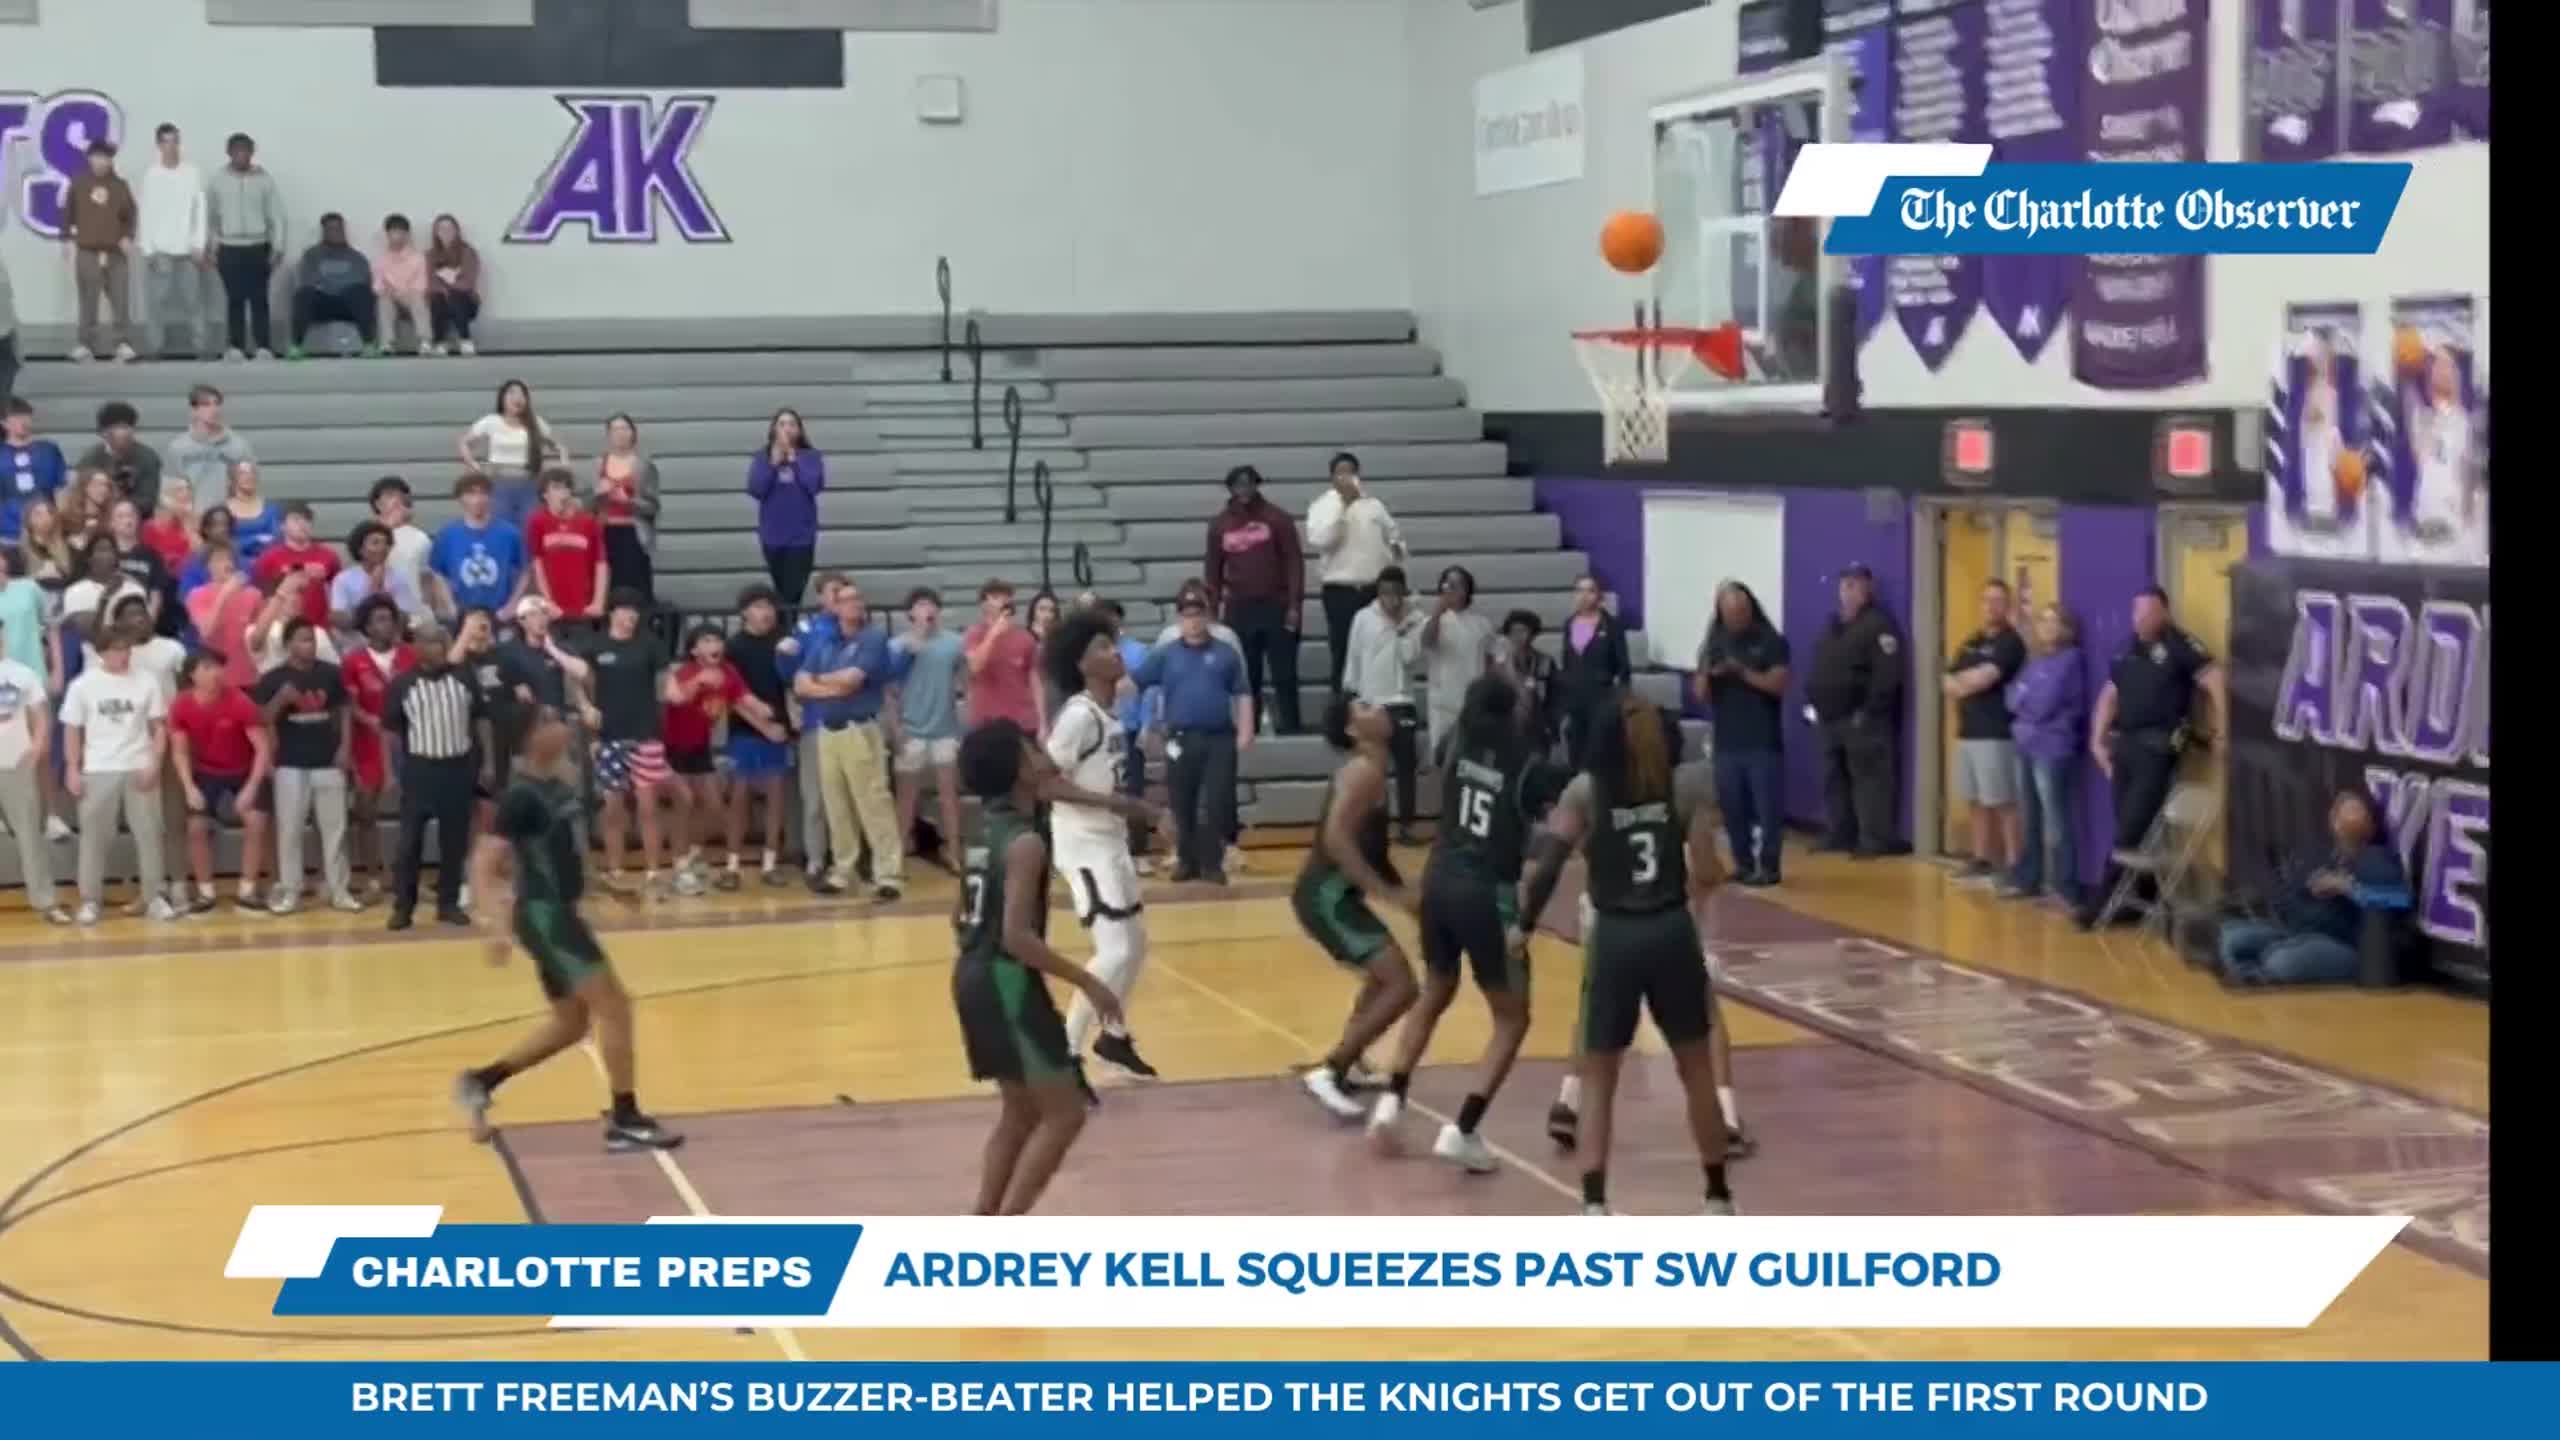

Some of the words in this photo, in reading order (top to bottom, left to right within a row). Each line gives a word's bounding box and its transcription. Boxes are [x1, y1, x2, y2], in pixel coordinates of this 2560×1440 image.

[502, 95, 733, 243] AK
[2274, 590, 2490, 768] ARD
[1459, 785, 1494, 838] 15
[1629, 831, 1658, 884] 3
